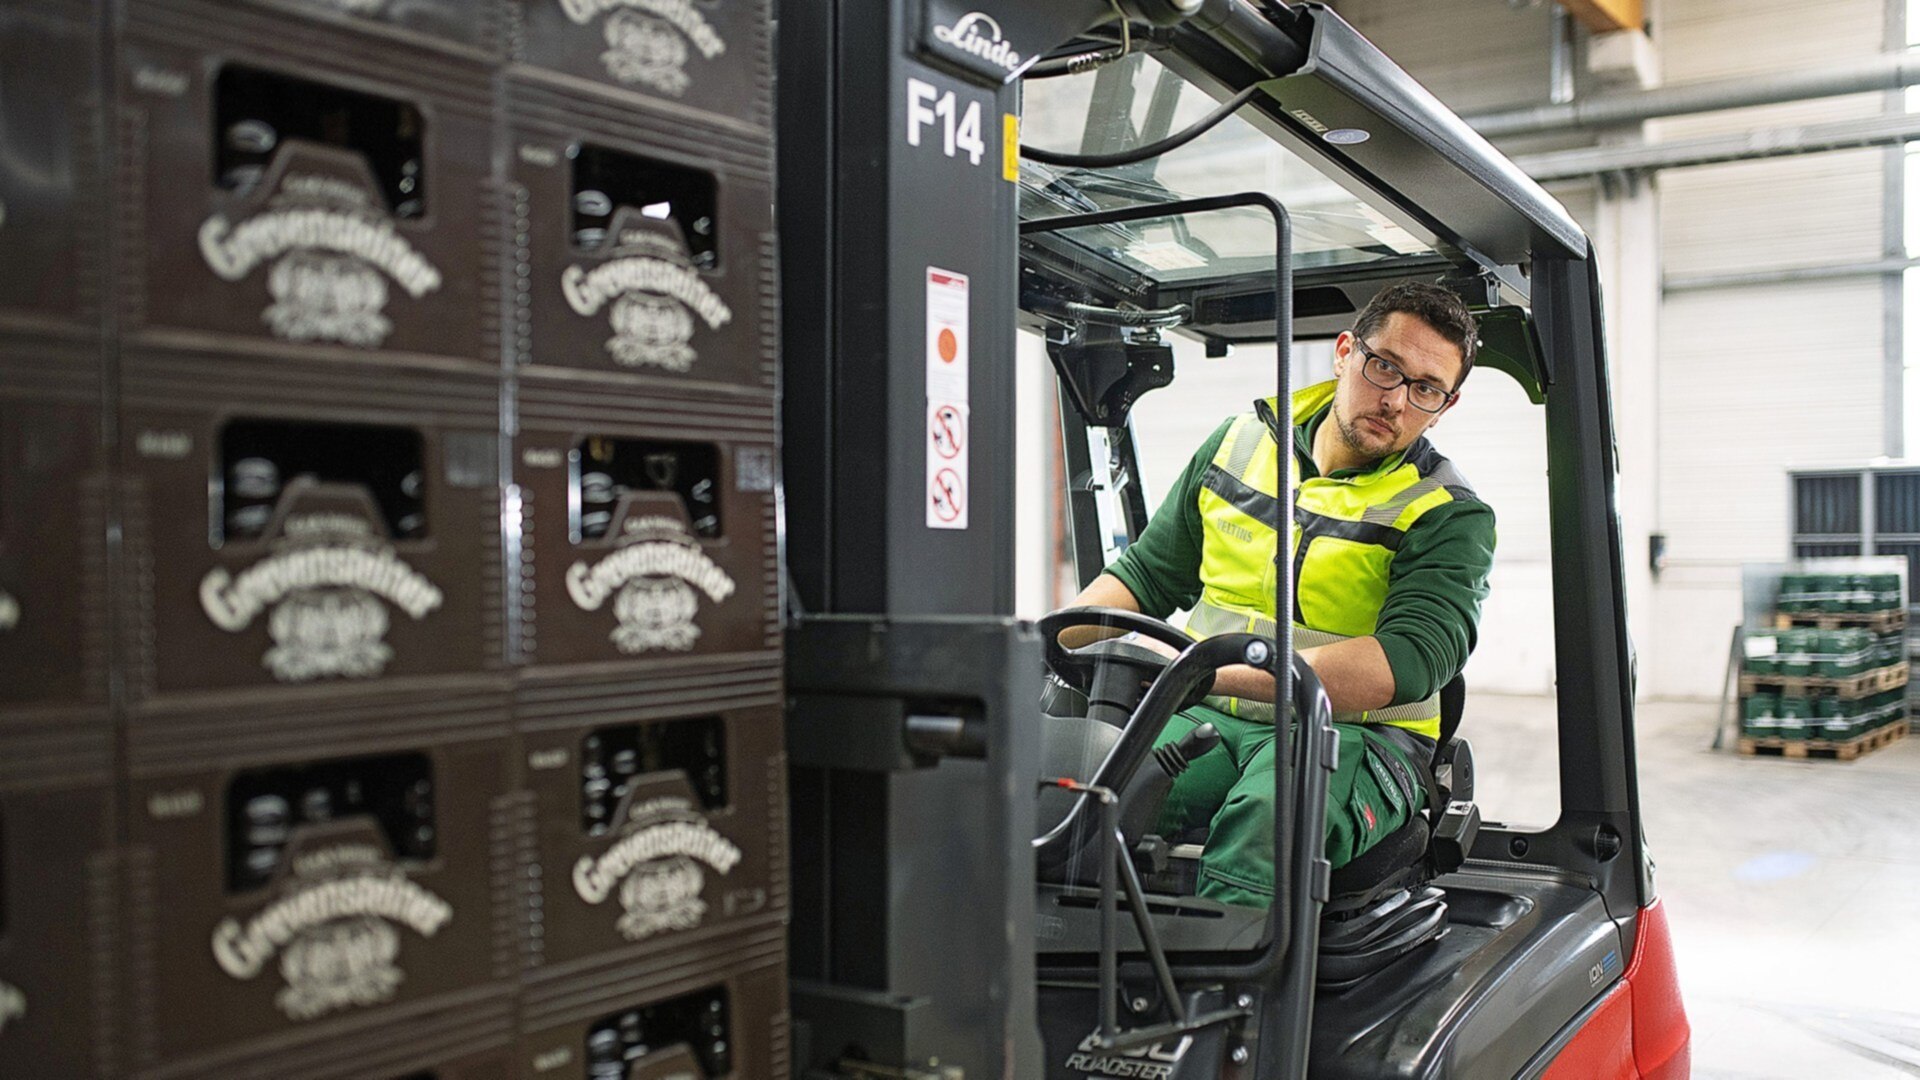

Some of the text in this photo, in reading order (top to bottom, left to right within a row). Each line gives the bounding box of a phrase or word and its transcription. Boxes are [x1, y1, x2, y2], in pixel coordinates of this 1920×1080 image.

[933, 11, 1020, 71] Linde
[907, 77, 985, 166] F14
[1217, 517, 1253, 543] VELTINS
[1065, 1052, 1173, 1080] ROADSTER
